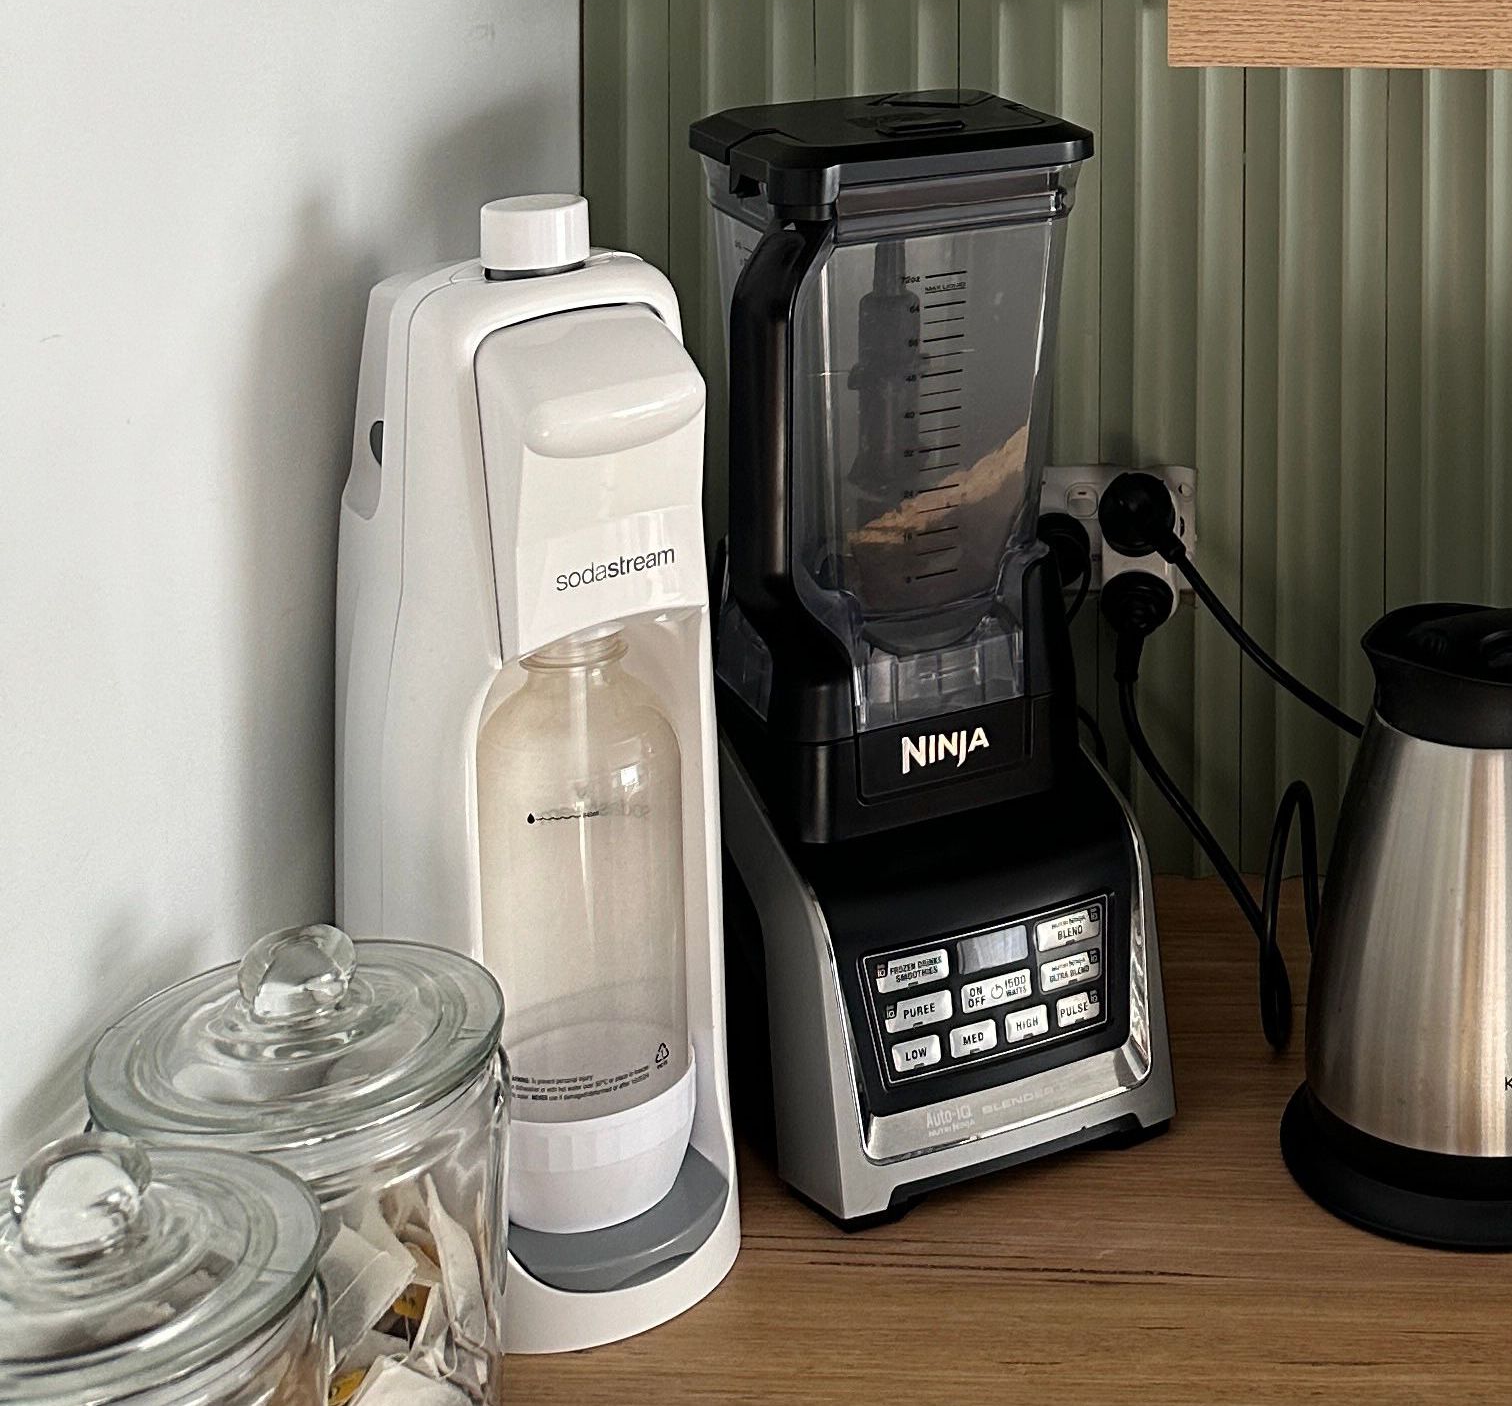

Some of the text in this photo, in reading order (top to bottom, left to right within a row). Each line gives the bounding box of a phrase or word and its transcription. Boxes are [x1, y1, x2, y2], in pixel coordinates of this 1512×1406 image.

[556, 548, 675, 591] sodastream
[902, 727, 989, 774] NINJA
[1057, 925, 1083, 941] BLEND
[969, 974, 1026, 997] ON 1500
[968, 986, 1027, 1008] OFF WATTS
[903, 1002, 936, 1020] PUREE
[1060, 1001, 1089, 1019] PULSE
[1016, 1016, 1039, 1032] HIGH
[962, 1031, 984, 1046] MED
[905, 1047, 928, 1062] LOW
